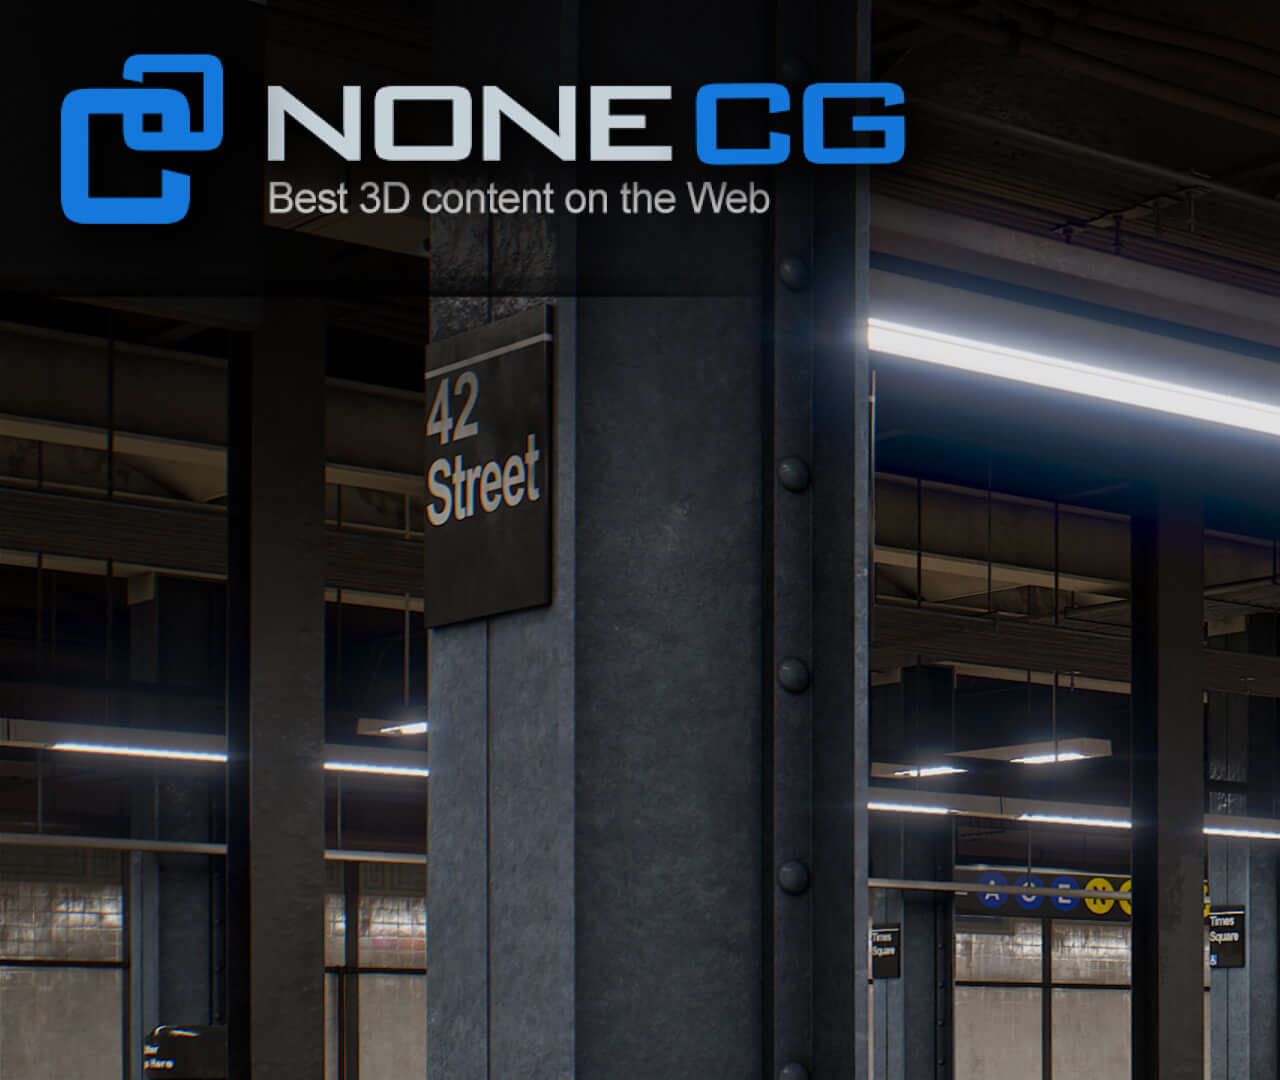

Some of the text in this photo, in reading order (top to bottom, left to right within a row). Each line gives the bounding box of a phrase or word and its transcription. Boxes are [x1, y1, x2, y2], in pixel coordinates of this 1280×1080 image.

[426, 371, 479, 445] 42
[426, 433, 541, 526] Street
[1208, 916, 1235, 927] Times
